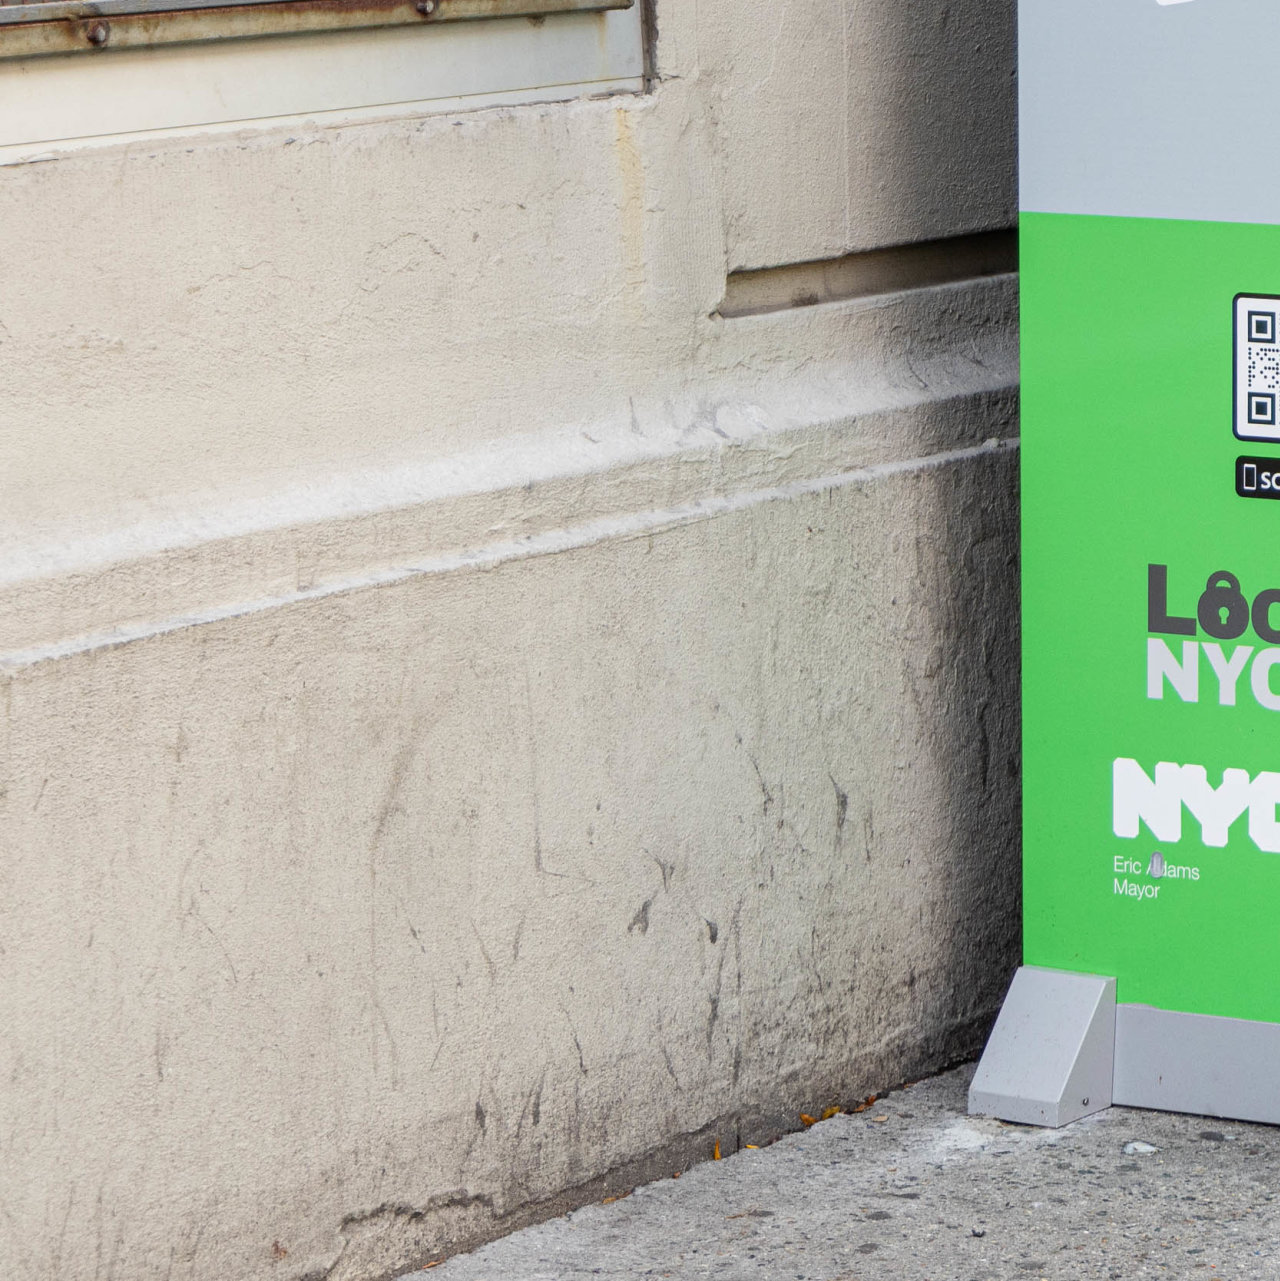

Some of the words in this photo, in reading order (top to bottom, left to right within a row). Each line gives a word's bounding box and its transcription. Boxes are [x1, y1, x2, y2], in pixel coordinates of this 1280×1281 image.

[1114, 855, 1142, 874] Eric
[1146, 860, 1200, 880] dams
[1114, 878, 1160, 901] Mayor
